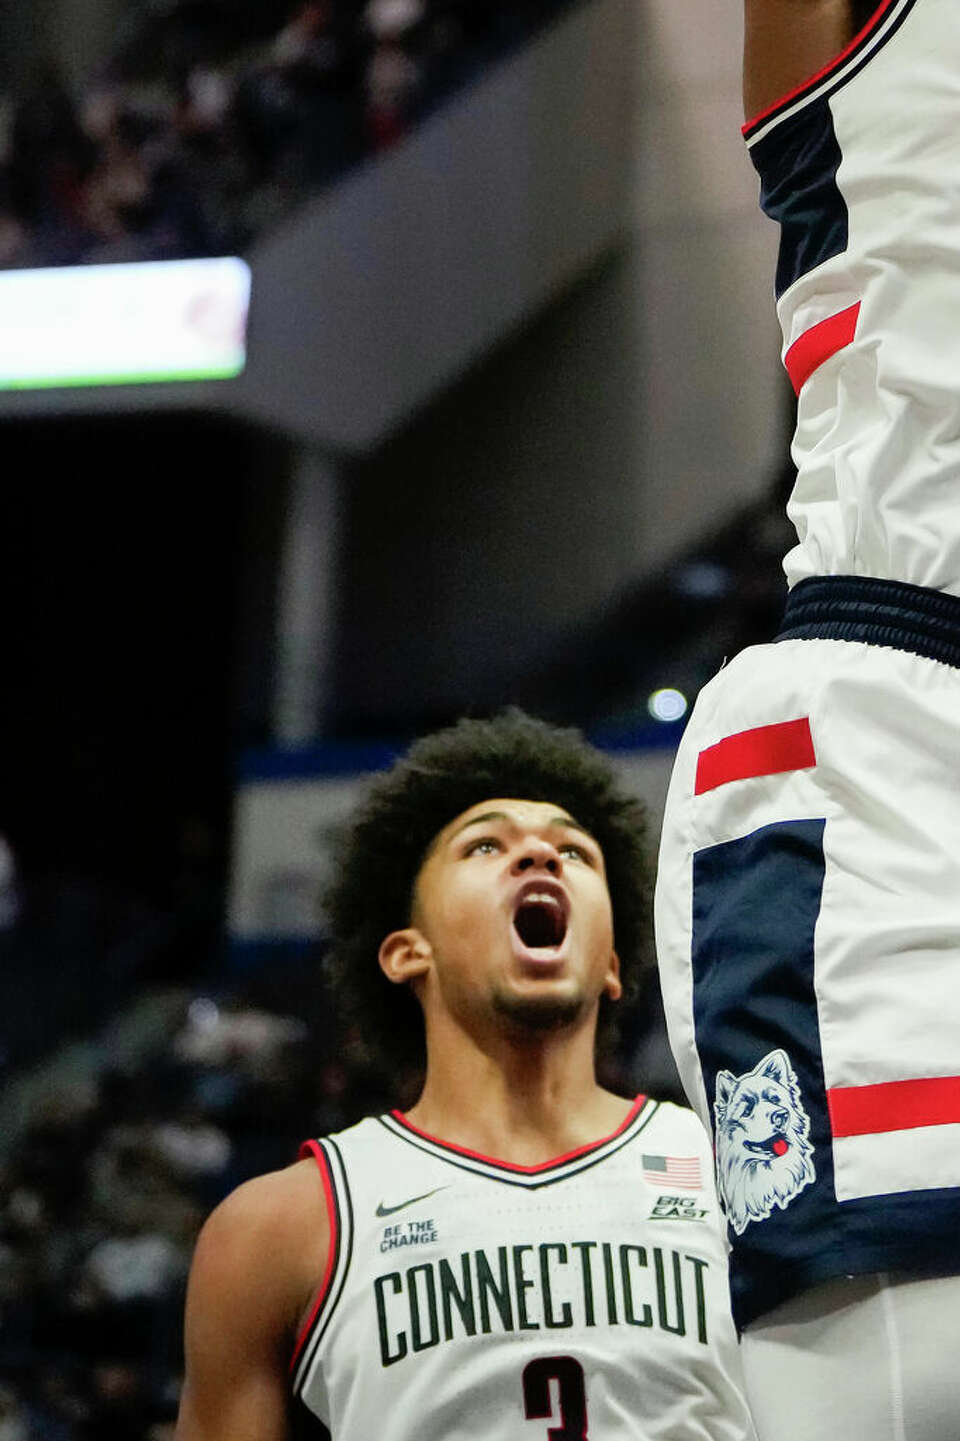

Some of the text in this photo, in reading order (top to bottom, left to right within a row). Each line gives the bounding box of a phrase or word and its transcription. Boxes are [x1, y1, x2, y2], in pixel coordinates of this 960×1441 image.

[655, 1195, 697, 1208] BIG
[650, 1206, 710, 1219] EAST
[383, 1219, 435, 1240] BE THE
[379, 1229, 439, 1254] CHANGE
[373, 1240, 710, 1368] CONNECTICUT
